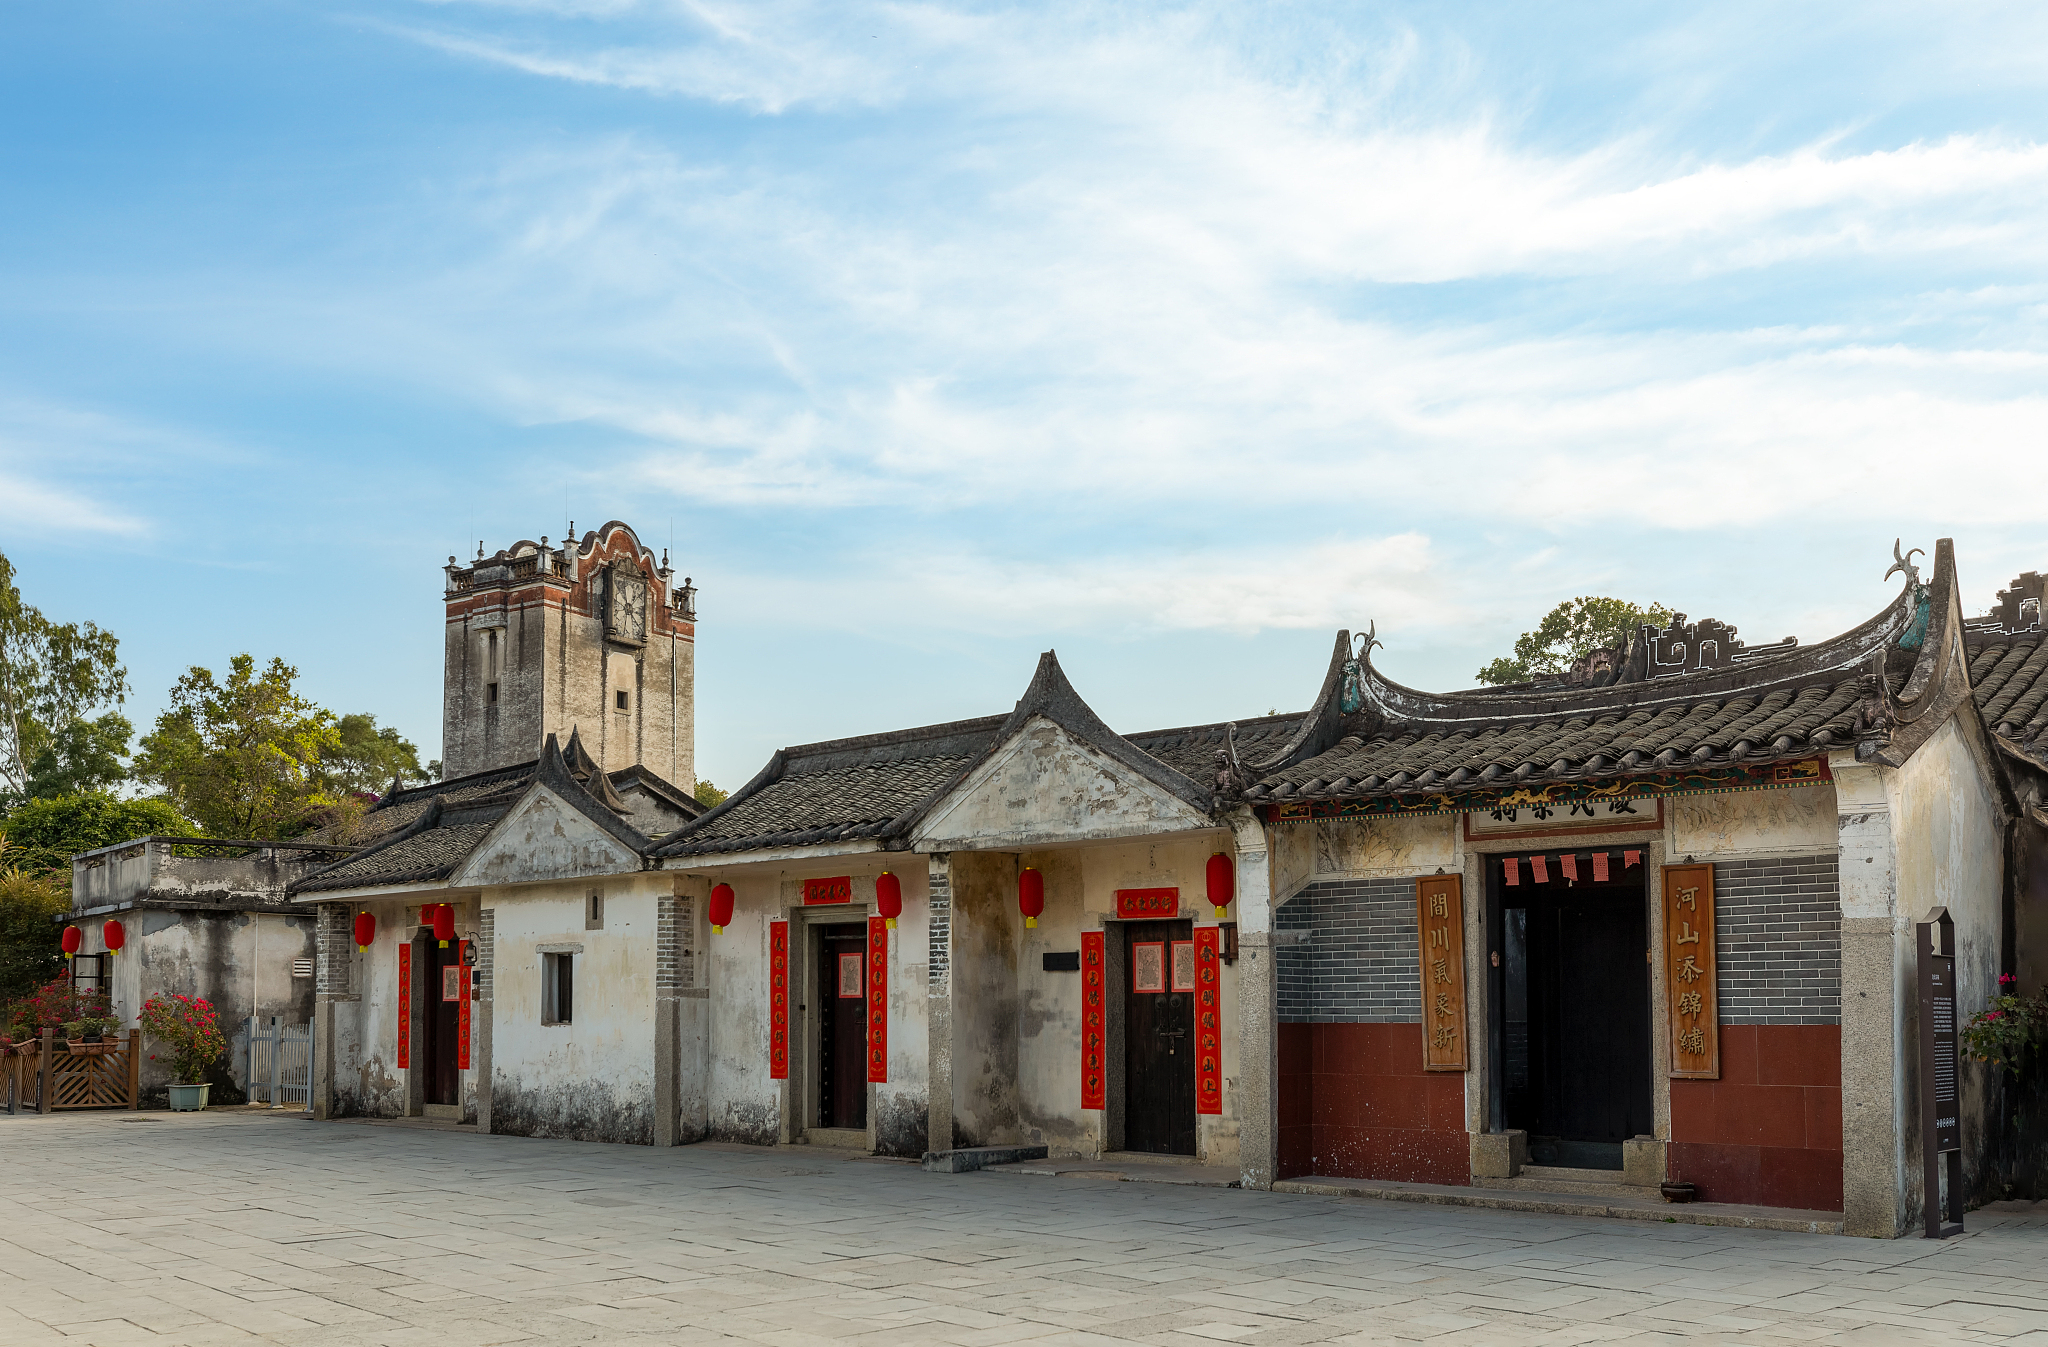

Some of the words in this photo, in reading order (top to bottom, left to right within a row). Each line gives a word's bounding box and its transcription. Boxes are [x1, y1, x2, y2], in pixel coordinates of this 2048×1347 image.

[1200, 944, 1218, 1093] 春光明媚江山上
[1428, 891, 1458, 1052] 間川氣象新
[1675, 885, 1706, 1056] 河山添錦繡
